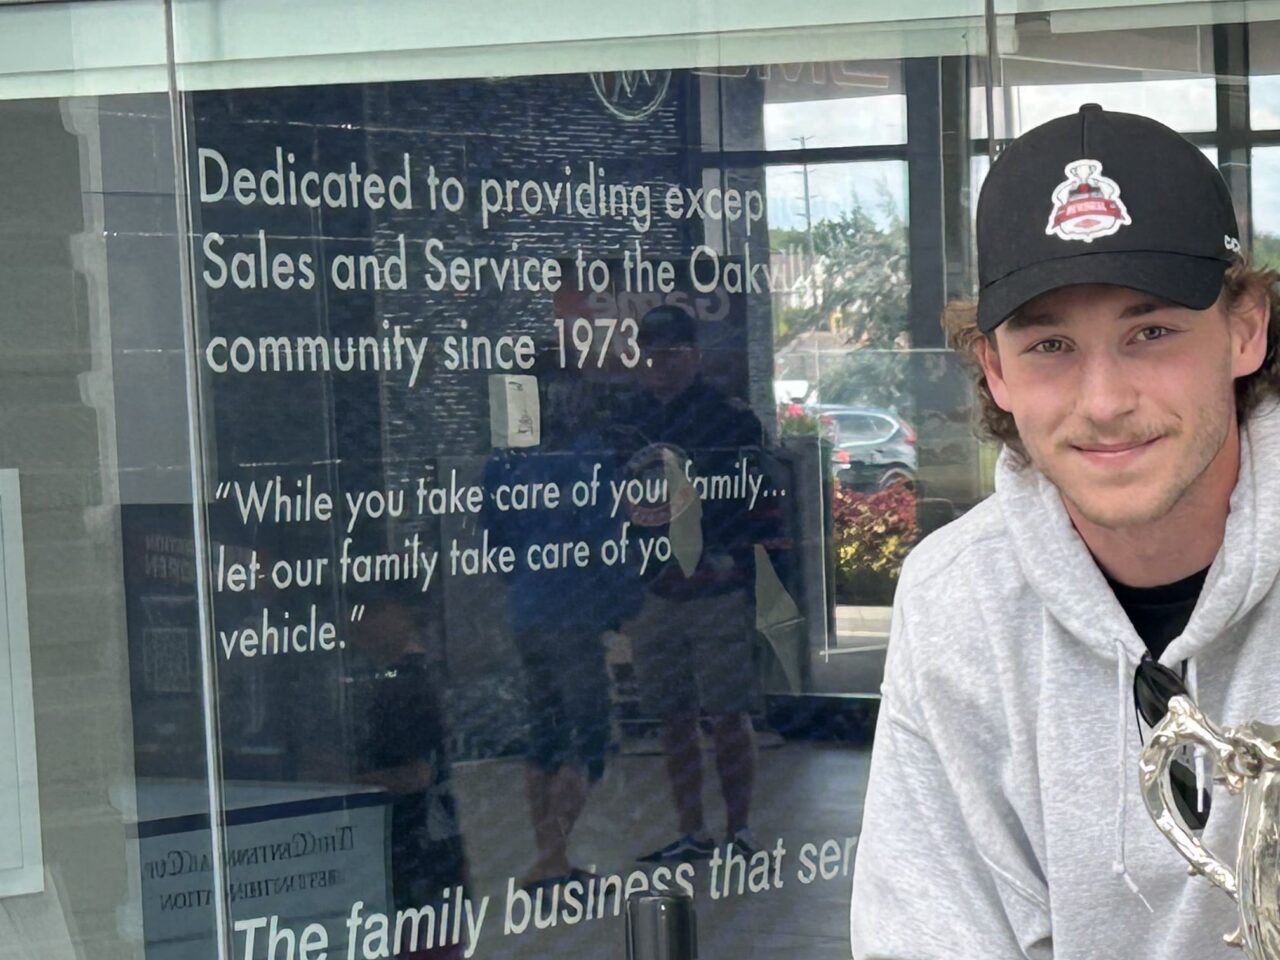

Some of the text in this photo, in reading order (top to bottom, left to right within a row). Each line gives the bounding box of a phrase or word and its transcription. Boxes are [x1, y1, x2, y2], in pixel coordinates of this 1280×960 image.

[198, 146, 765, 236] Dedicated to providing excep
[202, 230, 316, 291] Sales
[331, 233, 409, 291] and
[425, 237, 563, 293] Service
[574, 243, 611, 294] to
[624, 241, 676, 293] the
[205, 317, 655, 388] community since 1973.
[346, 489, 406, 532] you
[416, 468, 485, 515] take
[495, 482, 562, 511] care
[572, 464, 603, 508] of
[217, 544, 262, 592] let
[271, 557, 330, 589] our
[340, 537, 439, 592] family
[449, 529, 517, 576] take
[526, 541, 591, 571] care
[601, 521, 632, 566] of
[638, 535, 673, 577] yo
[504, 864, 696, 936] business
[710, 837, 786, 900] that
[797, 834, 858, 885] ser
